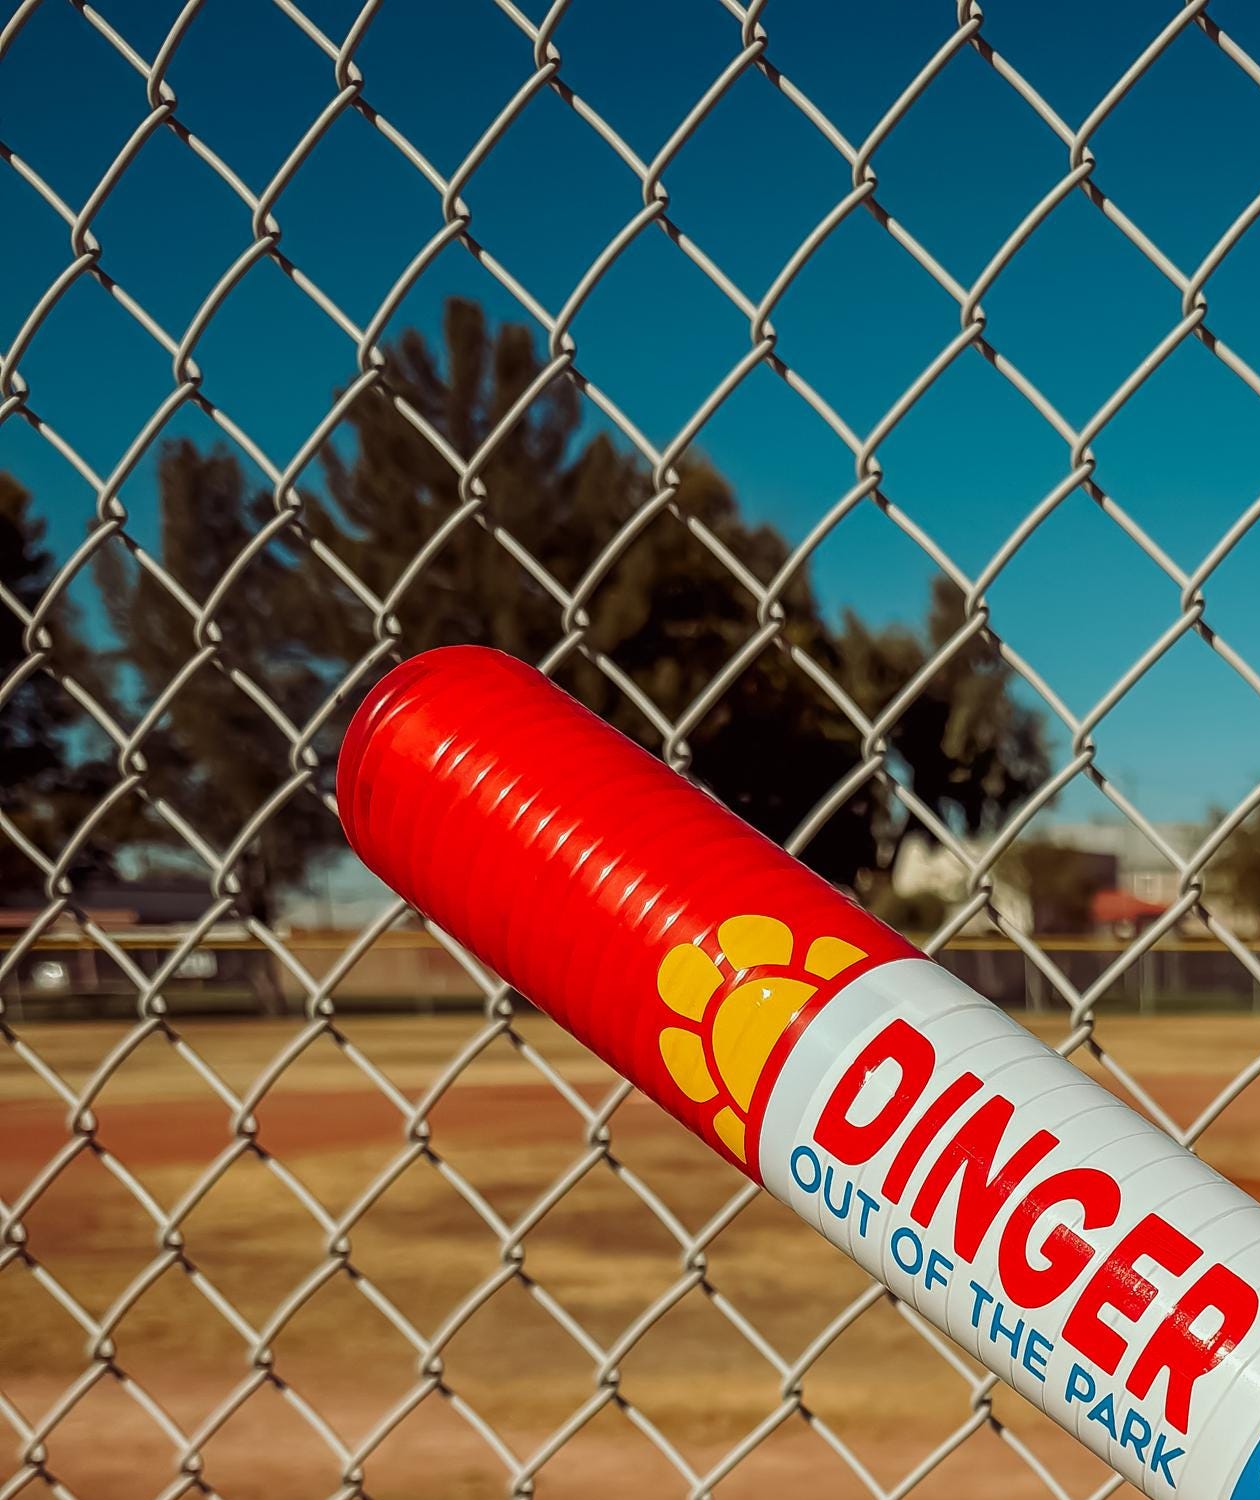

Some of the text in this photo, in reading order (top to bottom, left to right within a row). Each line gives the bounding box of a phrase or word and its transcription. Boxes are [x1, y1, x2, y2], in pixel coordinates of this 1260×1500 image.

[790, 1146, 1187, 1490] OUT OF THE PARK
[813, 1018, 1259, 1434] DINGER
